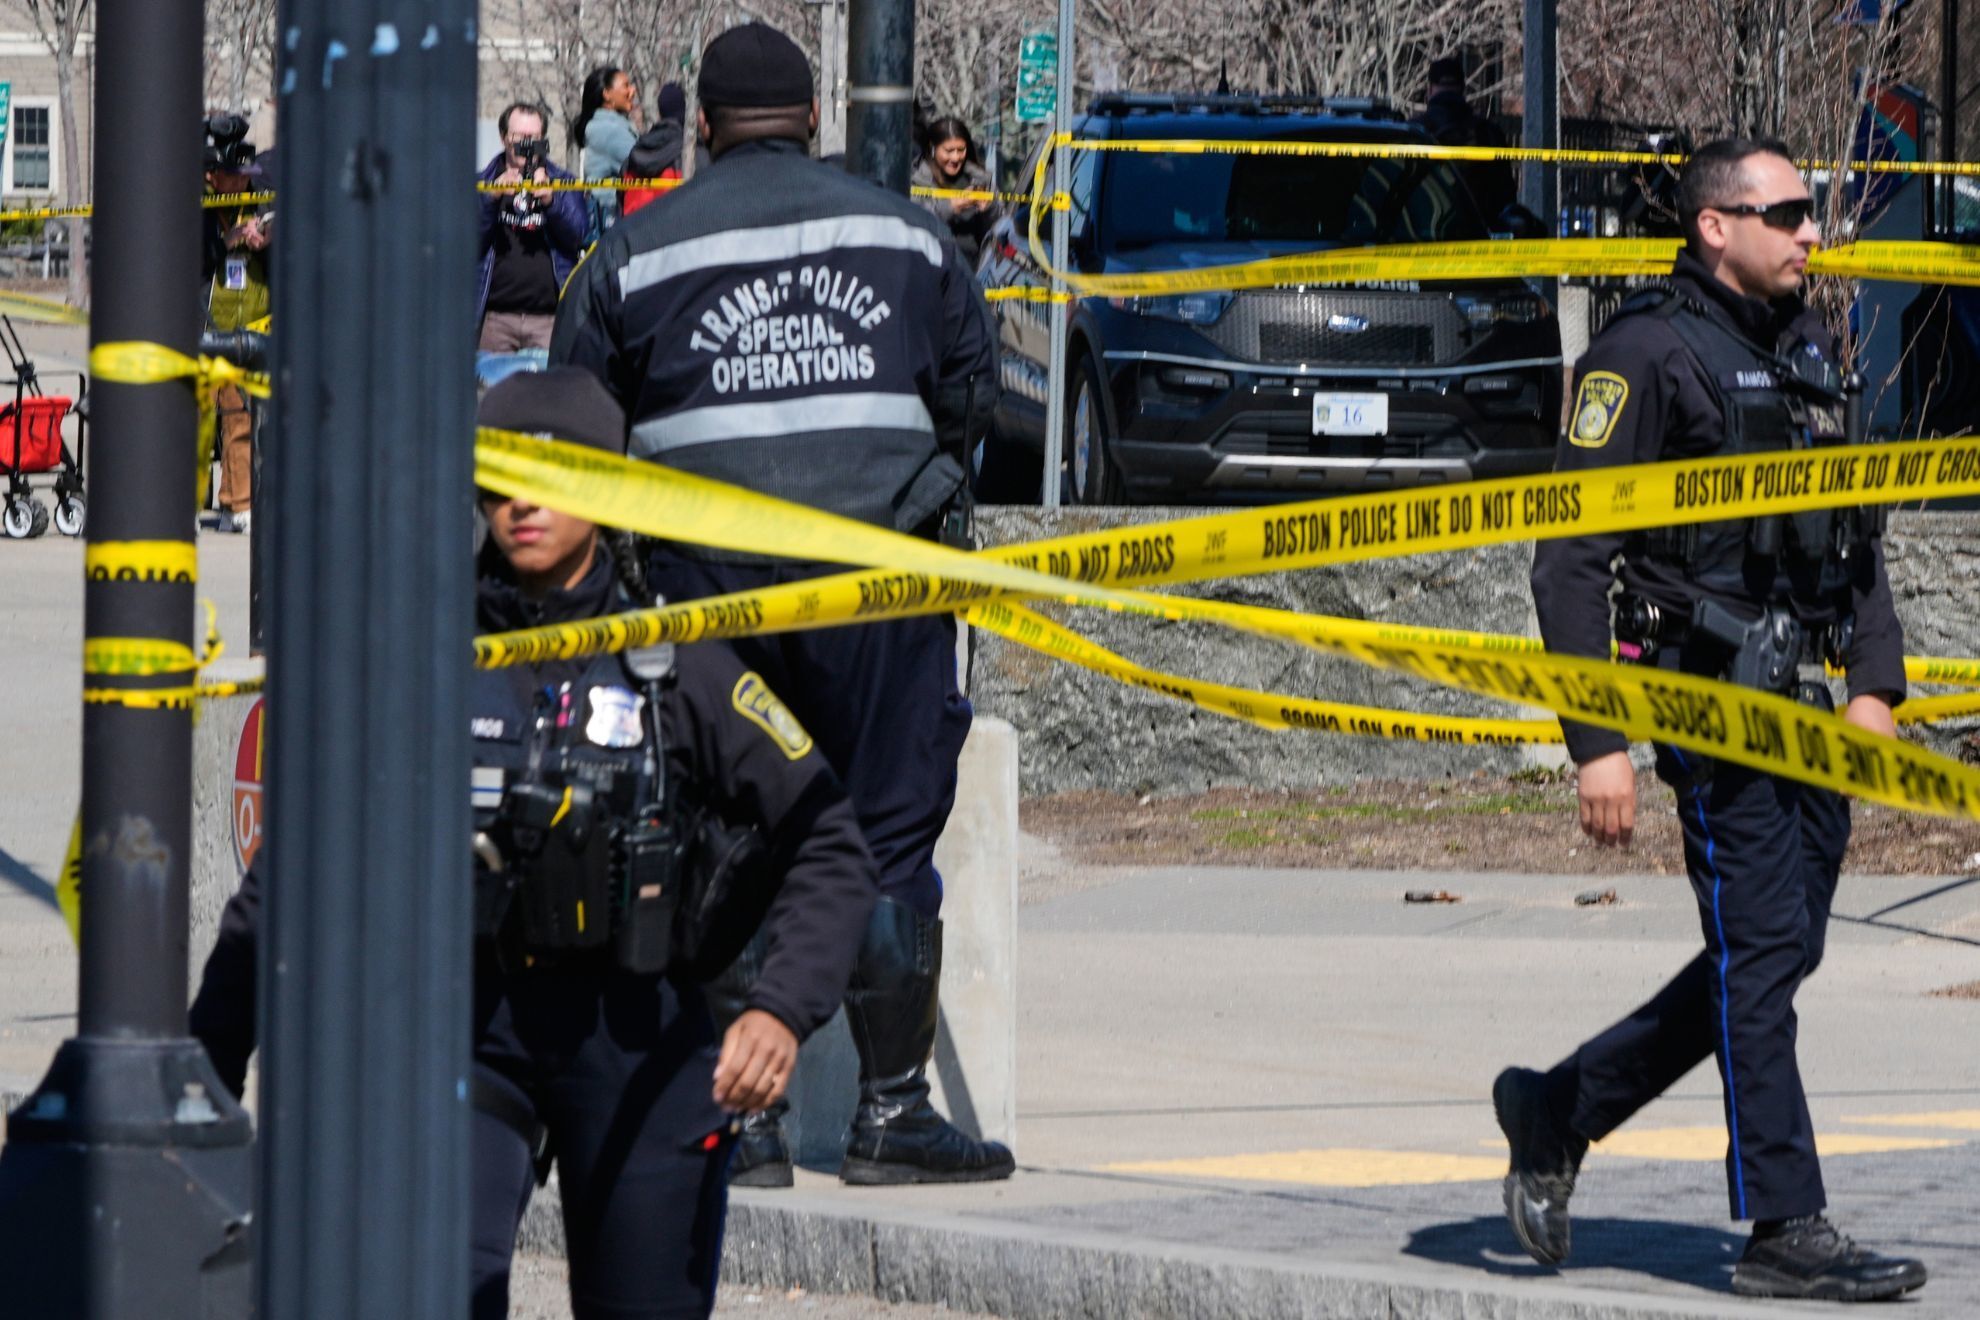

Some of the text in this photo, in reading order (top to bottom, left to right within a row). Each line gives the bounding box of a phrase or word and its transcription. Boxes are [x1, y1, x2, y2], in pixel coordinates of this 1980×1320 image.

[799, 265, 892, 331] POLICE
[737, 313, 844, 355] SPECIAL
[711, 344, 876, 394] OPERATIONS
[1736, 370, 1772, 388] RAMOS
[1343, 405, 1362, 426] 16
[1611, 480, 1637, 501] JWF
[1674, 465, 1745, 509] BOSTON
[1752, 458, 1816, 500] POLICE
[1819, 455, 1861, 493] LINE
[1863, 453, 1889, 489] DO
[1894, 451, 1934, 486] NOT
[1262, 483, 1582, 559] BOSTON POLICE LINE DO NOT CROSS
[1048, 549, 1071, 578] DO
[1079, 545, 1111, 583] NOT
[1115, 534, 1175, 581] CROSS
[856, 572, 930, 616] BOSTON
[1641, 680, 1728, 745] CROSS
[1740, 700, 1787, 763] NOT
[1795, 718, 1830, 775] DO
[1837, 732, 1889, 794] LINE
[1895, 753, 1967, 808] POLICE
